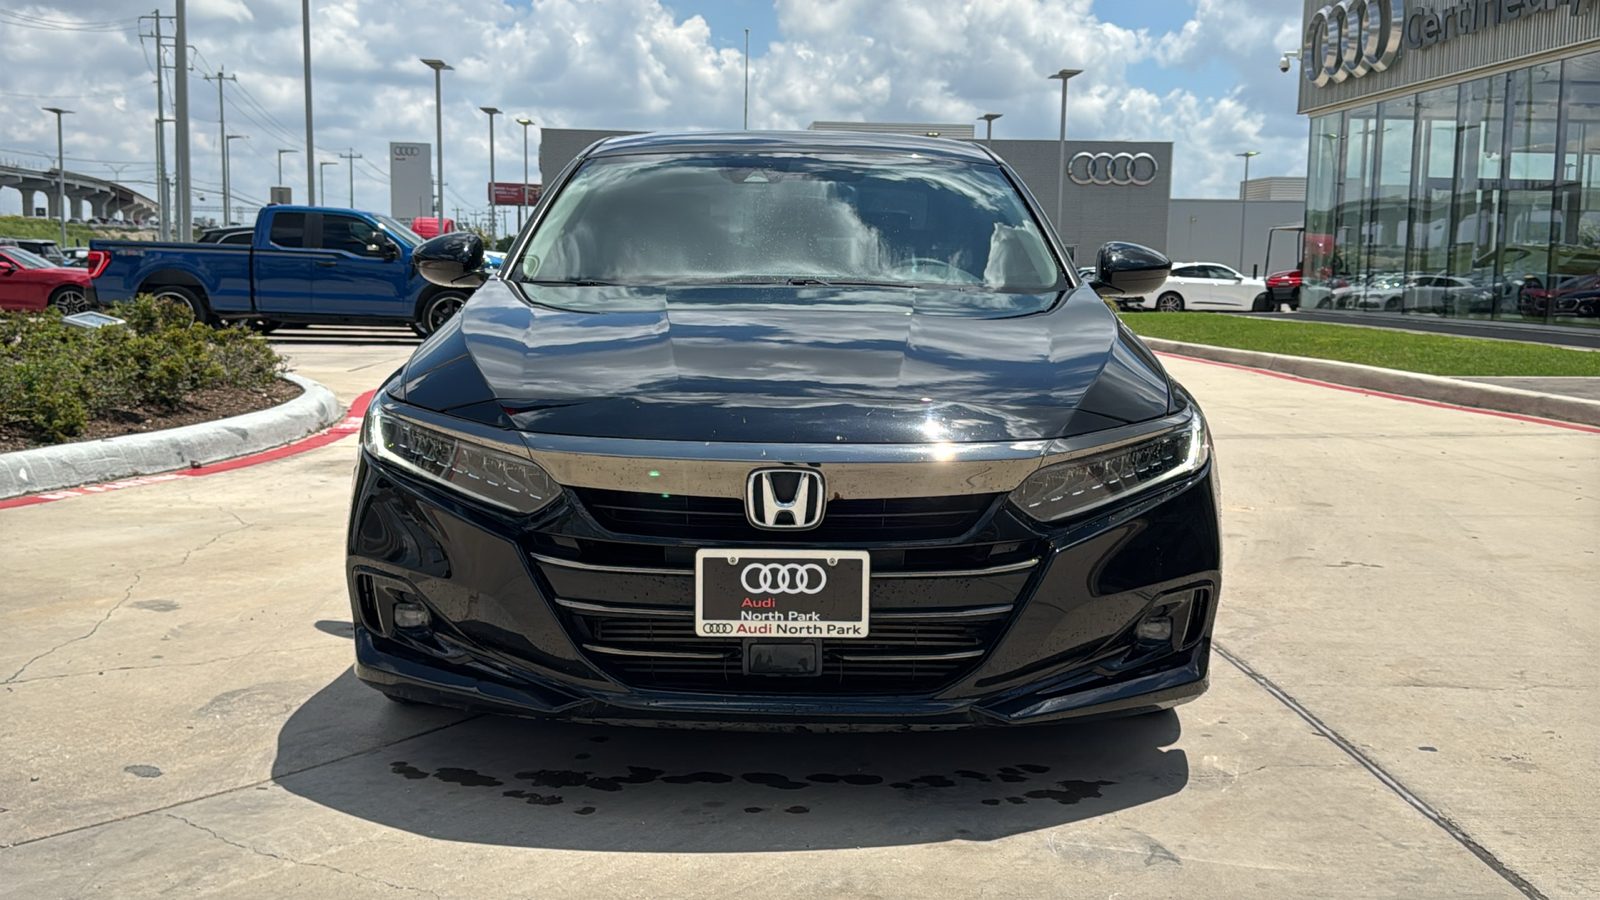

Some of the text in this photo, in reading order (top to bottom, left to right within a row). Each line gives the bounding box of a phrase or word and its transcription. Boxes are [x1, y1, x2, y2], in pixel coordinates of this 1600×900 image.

[741, 597, 776, 608] Audi
[741, 610, 820, 621] North Park
[736, 623, 862, 635] Audi North Park
